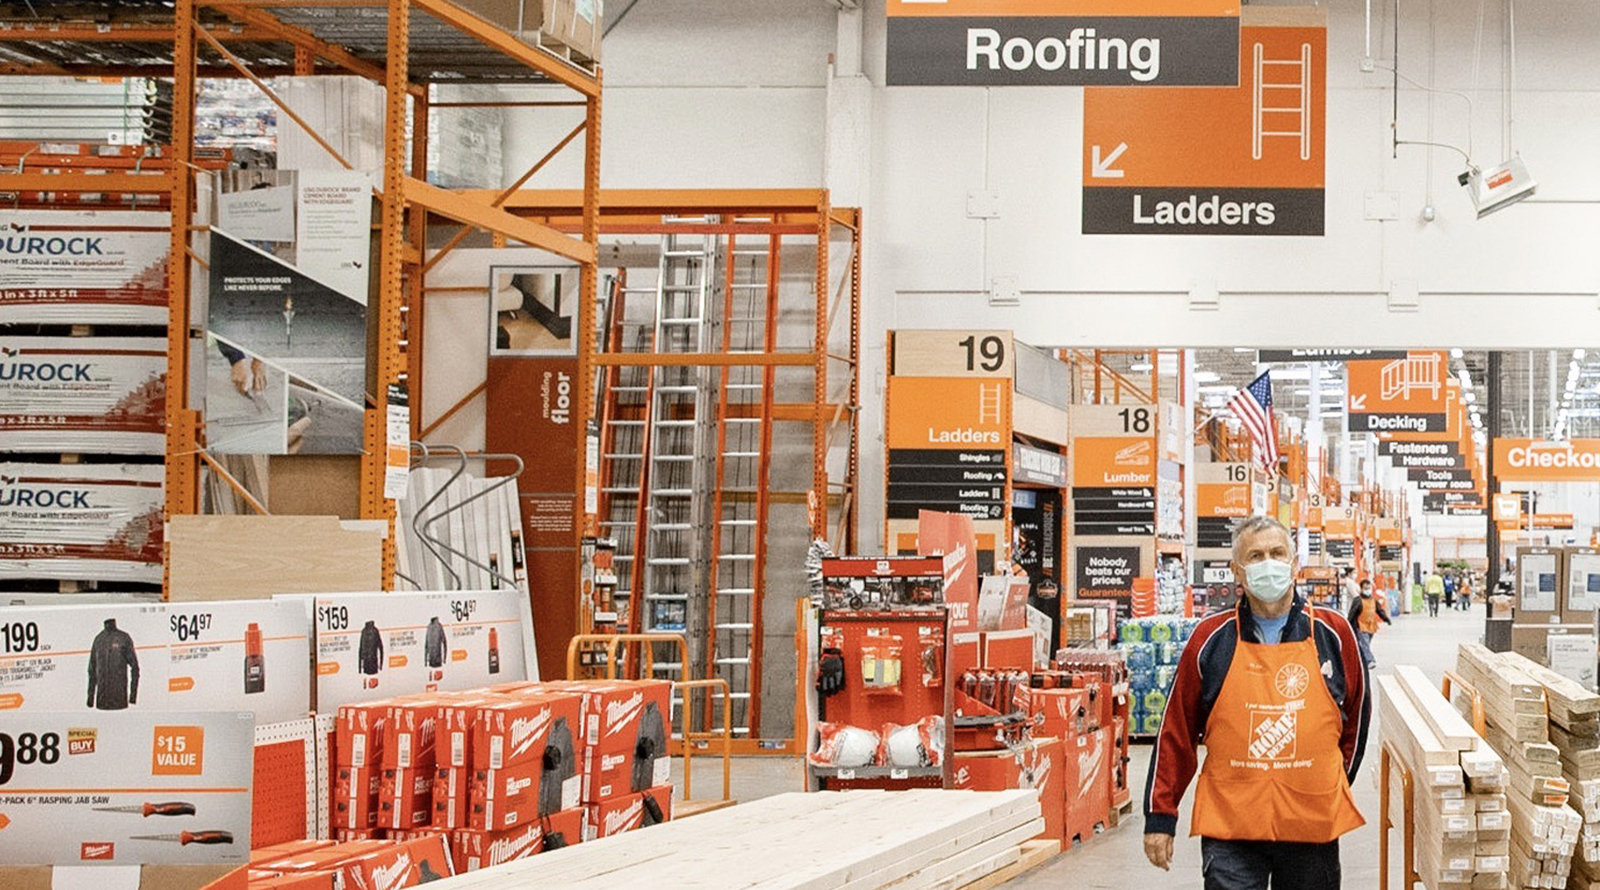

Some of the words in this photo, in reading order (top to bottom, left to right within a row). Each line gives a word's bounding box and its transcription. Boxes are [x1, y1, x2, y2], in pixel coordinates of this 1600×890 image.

[966, 28, 1160, 81] Roofing
[1133, 195, 1275, 226] Ladders
[959, 336, 1004, 372] 19
[541, 371, 552, 418] moulding
[551, 371, 571, 424] floor
[1118, 408, 1150, 433] 18
[1368, 415, 1427, 431] Decking
[928, 427, 1000, 443] Ladders
[1389, 442, 1448, 454] Fasteners
[959, 453, 991, 463] Shingles
[1403, 456, 1455, 466] Hardware
[963, 472, 993, 481] Roofing
[1104, 472, 1151, 483] Lumber
[1225, 465, 1247, 481] 16
[1426, 470, 1452, 480] Tools
[959, 490, 990, 498] Ladders
[960, 504, 989, 512] Roofing
[1089, 557, 1127, 568] Nobody
[1085, 567, 1112, 576] beats
[1114, 568, 1131, 576] our
[1092, 577, 1124, 586] prices.
[318, 606, 348, 630] $159
[1, 622, 39, 652] 199
[510, 707, 551, 748] Milwaukee
[1255, 717, 1273, 736] THE
[68, 730, 97, 738] SPECIAL
[1249, 711, 1294, 759] HOME
[70, 741, 94, 751] BUY
[158, 736, 186, 752] $15
[1266, 728, 1296, 760] DEPOT
[157, 754, 196, 766] VALUE
[1246, 761, 1269, 771] saving.
[1273, 760, 1291, 769] More
[0, 796, 25, 804] -PACK
[39, 796, 73, 804] RASPING
[74, 796, 90, 804] JAB
[92, 796, 110, 804] SAW
